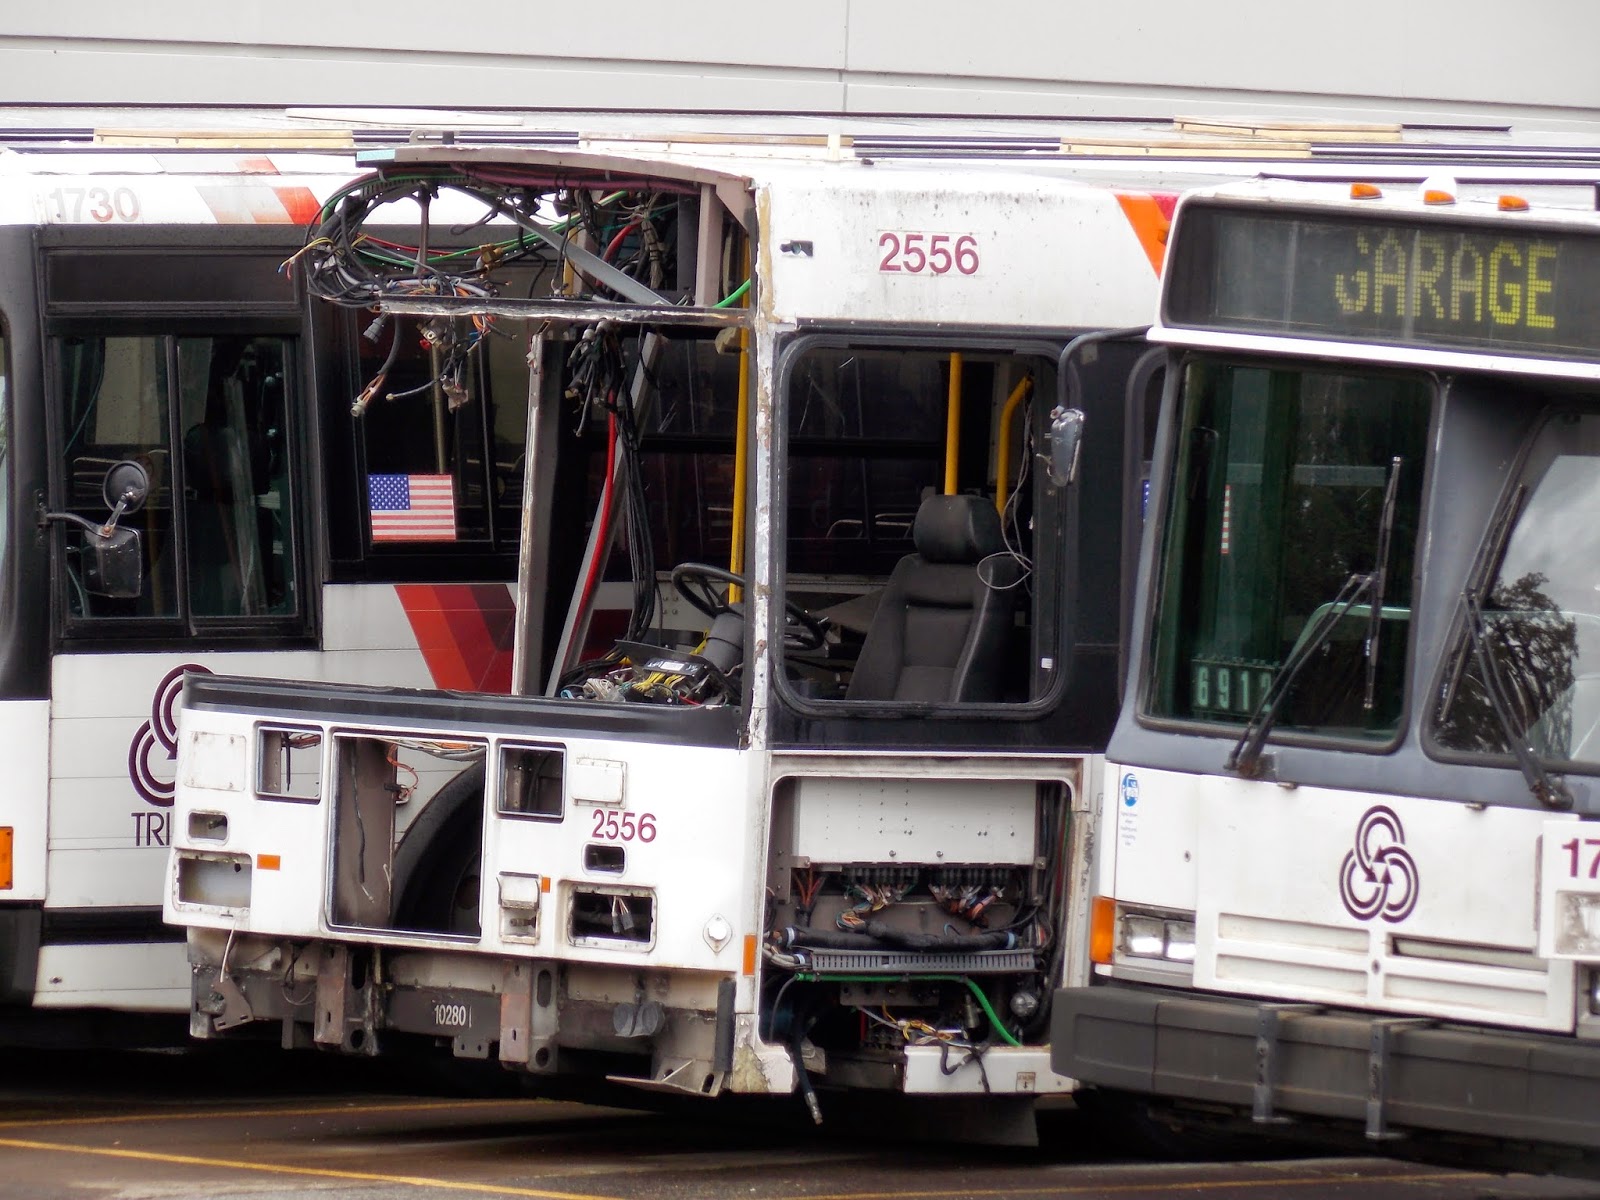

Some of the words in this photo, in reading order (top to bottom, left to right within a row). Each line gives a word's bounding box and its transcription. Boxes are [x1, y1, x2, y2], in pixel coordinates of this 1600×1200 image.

[49, 187, 140, 222] 1730
[879, 232, 979, 275] 2556
[1335, 231, 1557, 328] GARAGE
[131, 812, 170, 847] TRI
[592, 809, 657, 843] 2556
[434, 1004, 466, 1026] 10280
